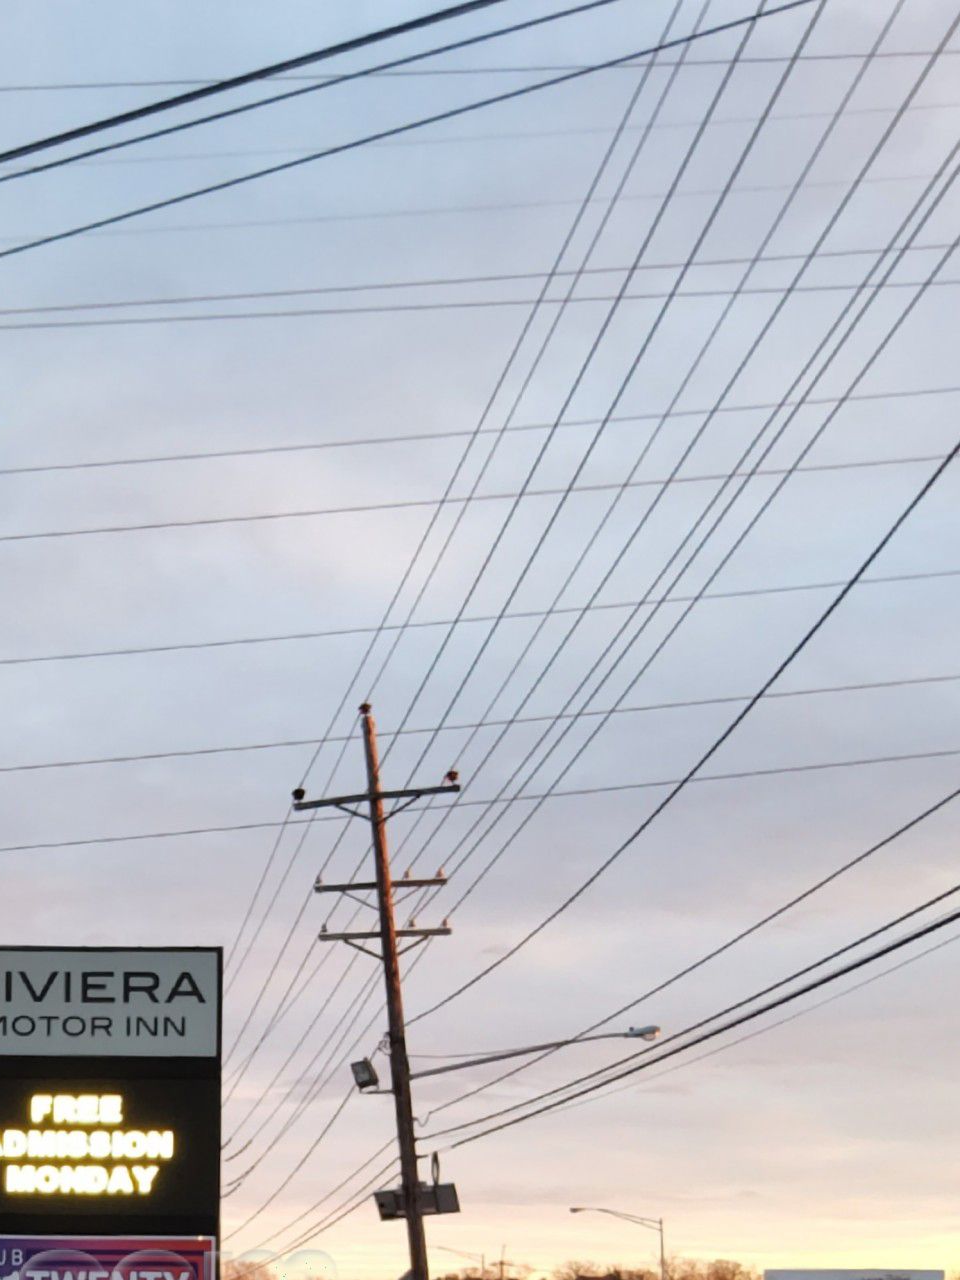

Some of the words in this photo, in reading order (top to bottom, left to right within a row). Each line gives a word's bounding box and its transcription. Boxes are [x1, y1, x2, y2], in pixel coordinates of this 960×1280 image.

[127, 1016, 187, 1037] INN
[30, 1095, 124, 1123] FREE
[5, 1165, 159, 1195] MONDAY
